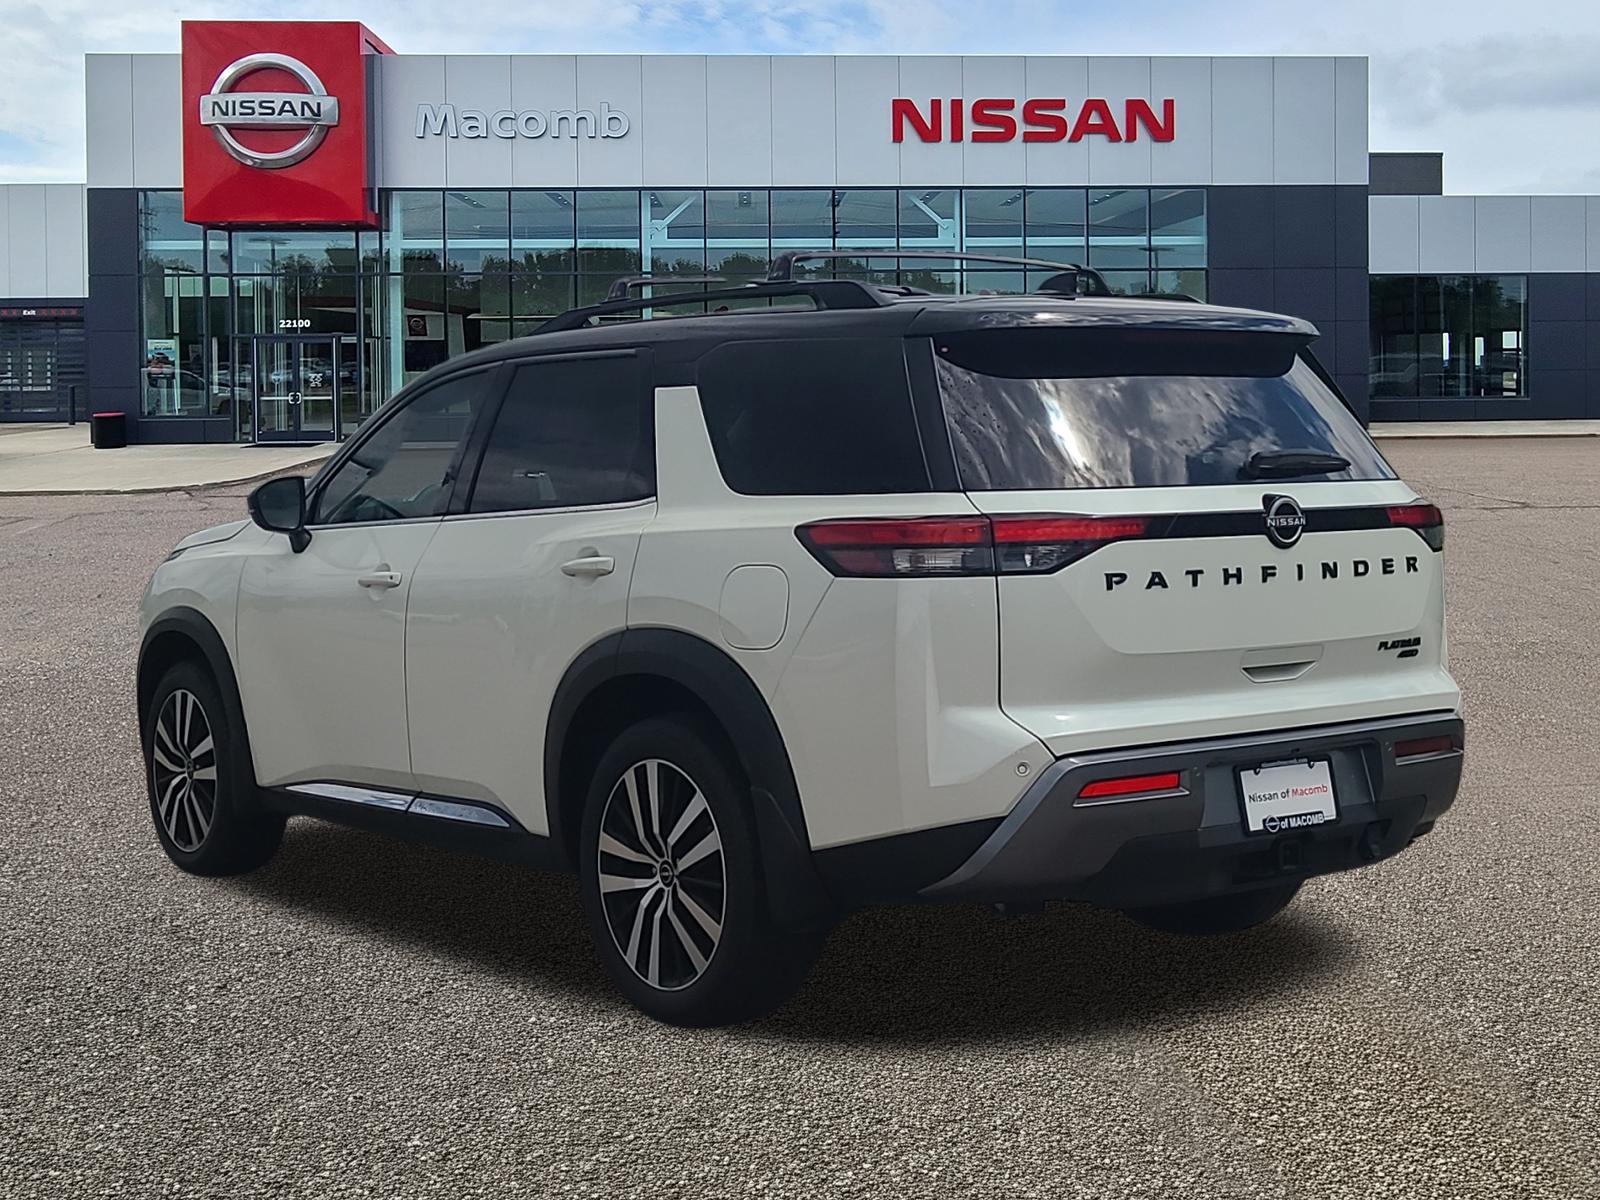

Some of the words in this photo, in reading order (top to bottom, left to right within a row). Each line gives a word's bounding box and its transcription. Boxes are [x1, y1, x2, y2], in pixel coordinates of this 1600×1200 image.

[211, 99, 322, 119] NISSAN
[415, 102, 630, 140] Macomb
[892, 98, 1176, 143] NISSAN
[279, 319, 311, 328] 22100
[1266, 514, 1306, 527] NISSAN
[1104, 556, 1419, 591] PATHFINDER
[1248, 791, 1279, 803] Nissan
[1280, 788, 1290, 799] of
[1291, 784, 1328, 797] Macomb
[1280, 818, 1288, 829] of
[1289, 814, 1325, 827] MACOMB
